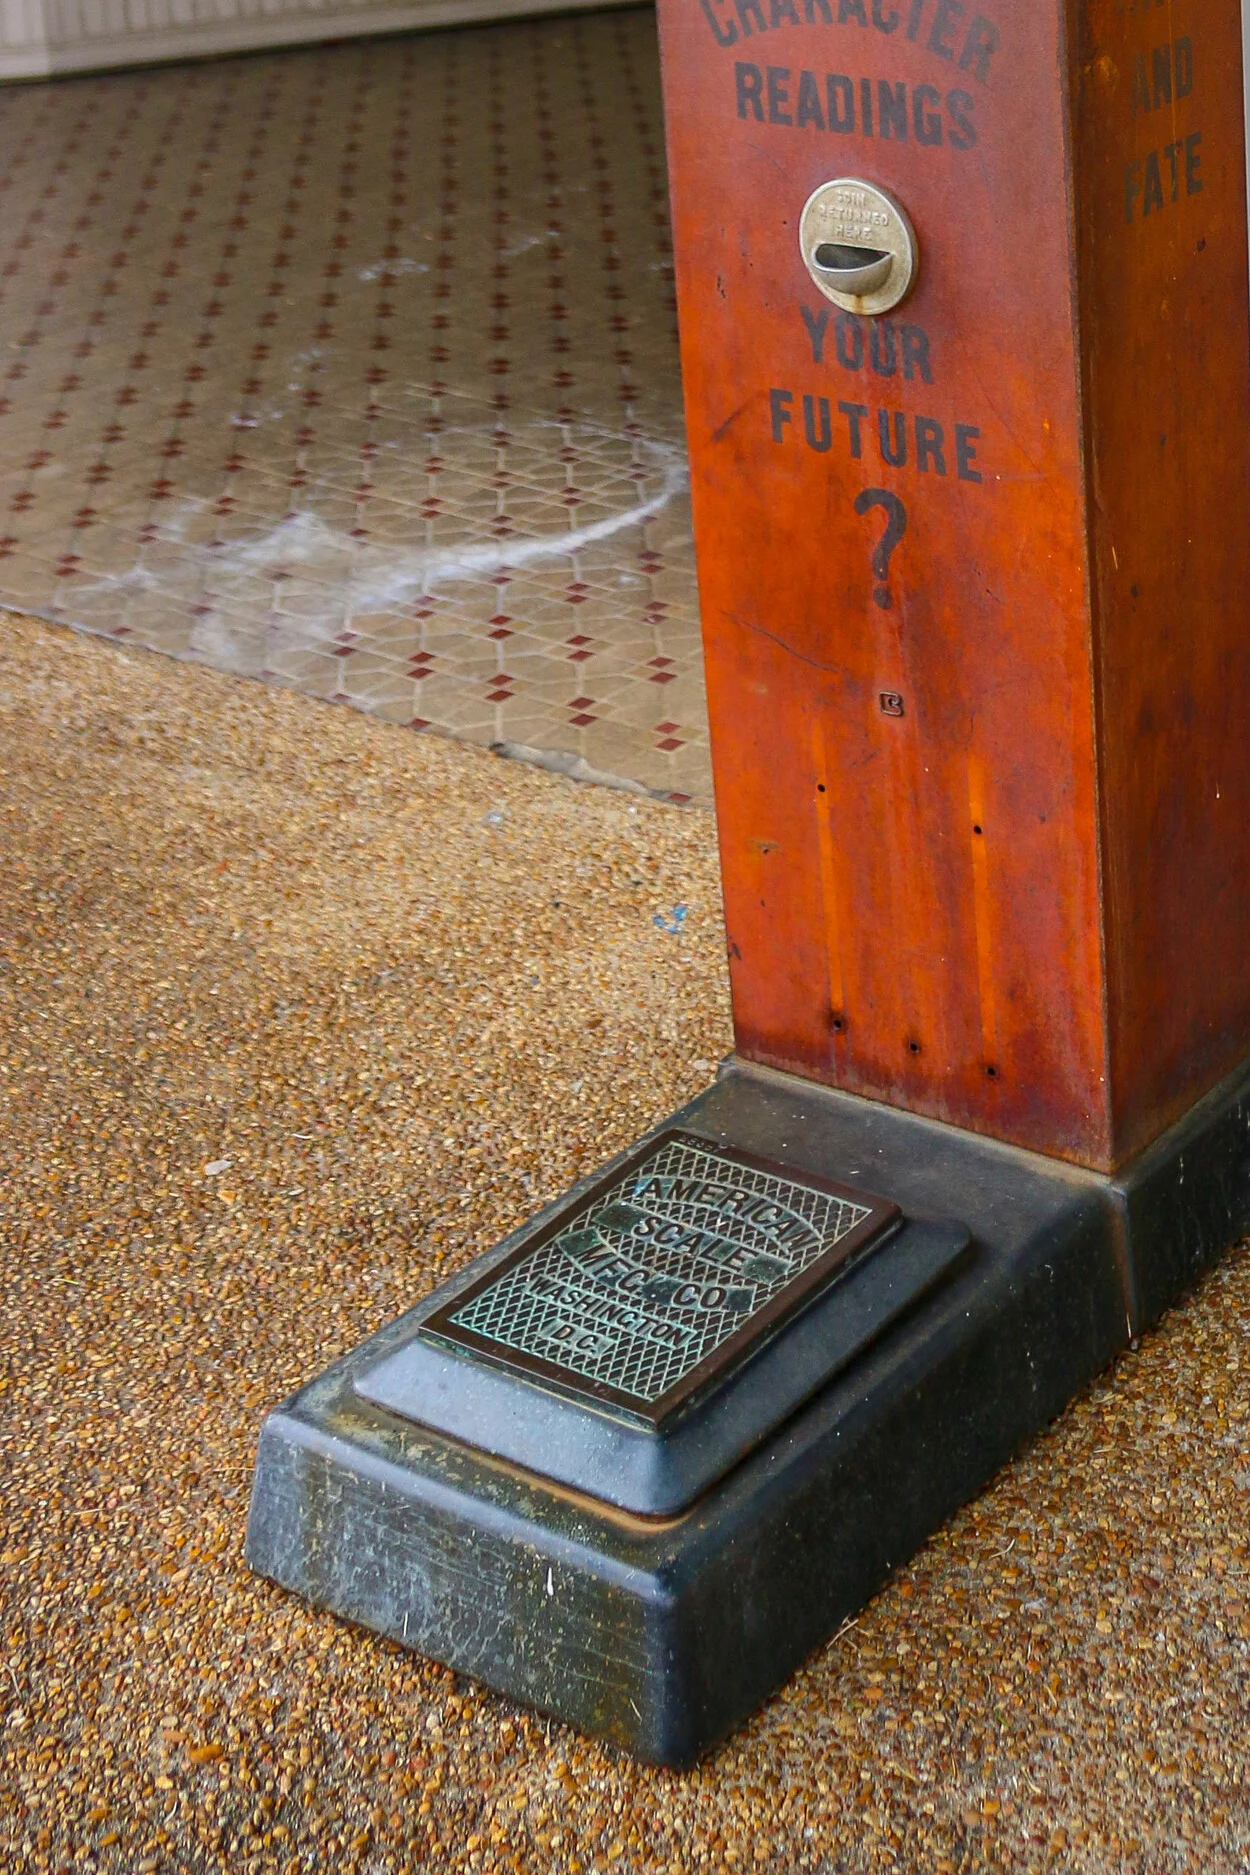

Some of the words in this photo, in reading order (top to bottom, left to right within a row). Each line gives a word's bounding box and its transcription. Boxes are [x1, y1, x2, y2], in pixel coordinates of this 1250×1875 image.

[733, 61, 979, 151] READINGS
[1130, 35, 1194, 118] AND
[819, 205, 888, 227] RETURNED
[1124, 132, 1203, 224] FATE
[835, 225, 872, 240] HERE
[800, 304, 934, 385] YOUR
[769, 388, 983, 484] FUTURE
[854, 487, 908, 610] ?
[632, 1216, 758, 1272] SCALE
[640, 1177, 822, 1248] AMERICAN
[528, 1276, 693, 1347] WASHINGTON
